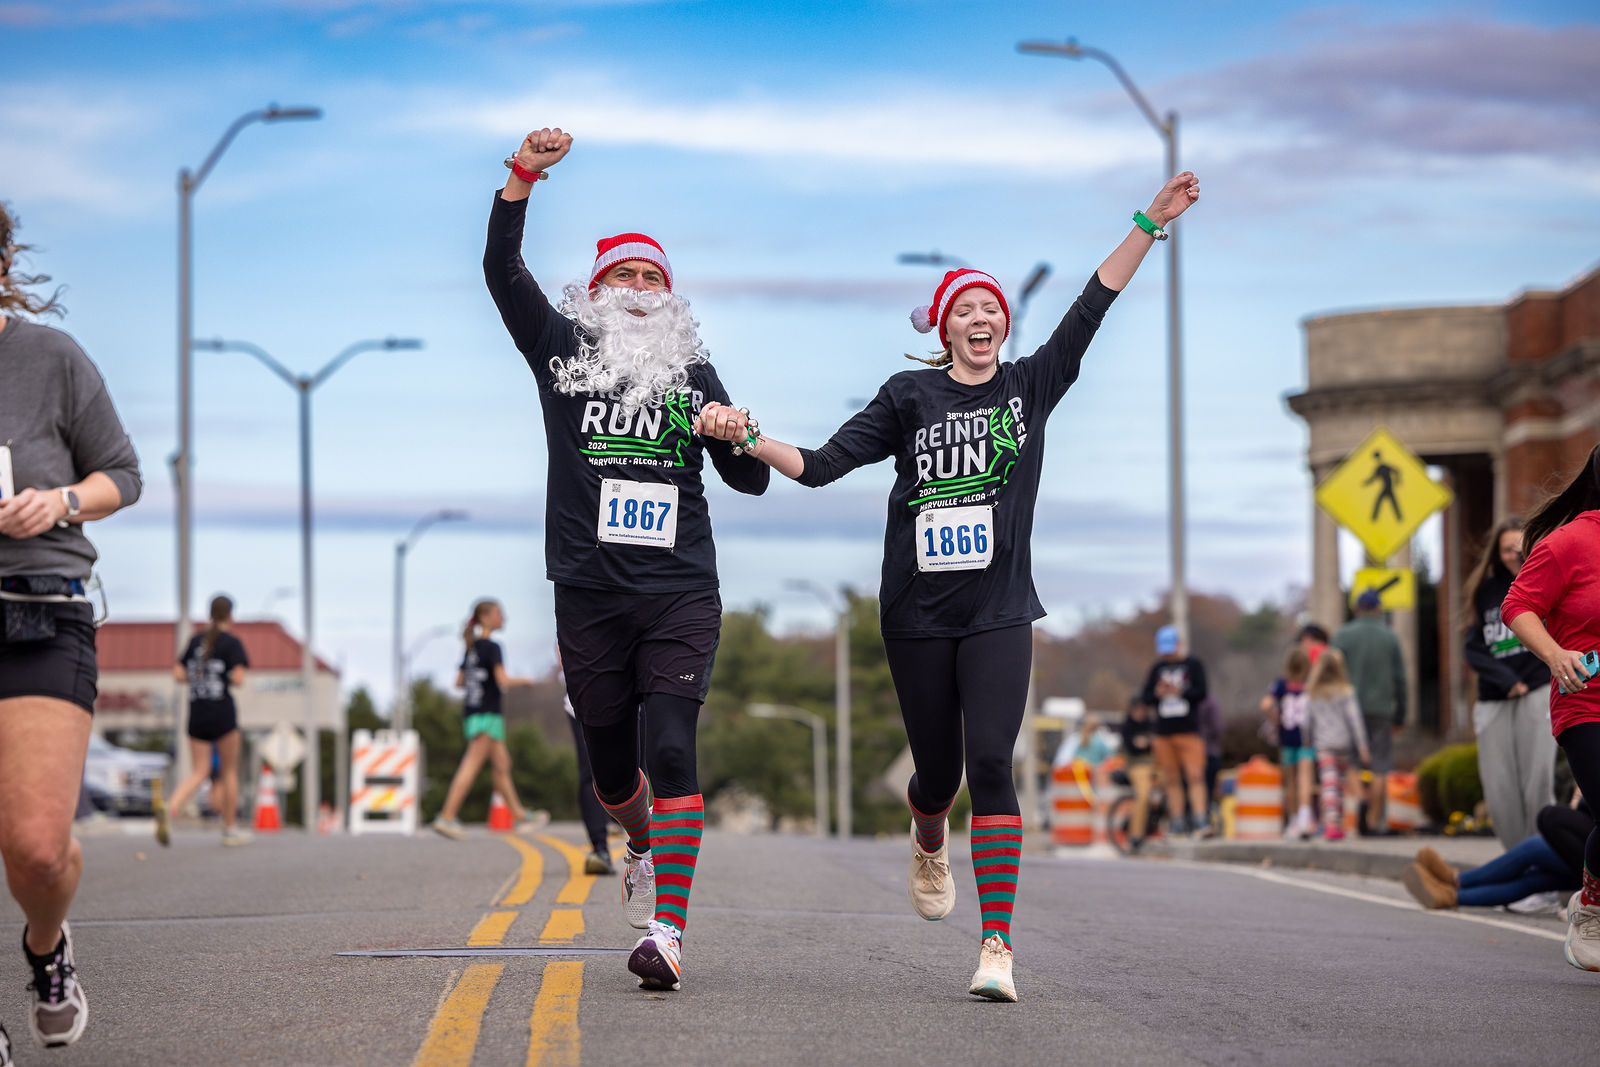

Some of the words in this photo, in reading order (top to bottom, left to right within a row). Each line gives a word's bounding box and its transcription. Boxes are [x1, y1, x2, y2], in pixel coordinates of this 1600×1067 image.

[580, 401, 662, 440] RUN
[946, 411, 963, 420] 38TH
[963, 406, 996, 420] ANNUA
[588, 441, 608, 450] 2024
[588, 457, 628, 467] MARYVILLE
[633, 457, 658, 467] ALCOA
[663, 460, 673, 468] TN
[914, 440, 986, 486] RUN
[919, 487, 937, 498] 2024
[919, 497, 958, 512] MARYVILLE
[962, 493, 986, 504] ALCOA
[607, 497, 671, 531] 1867
[924, 523, 988, 557] 1866
